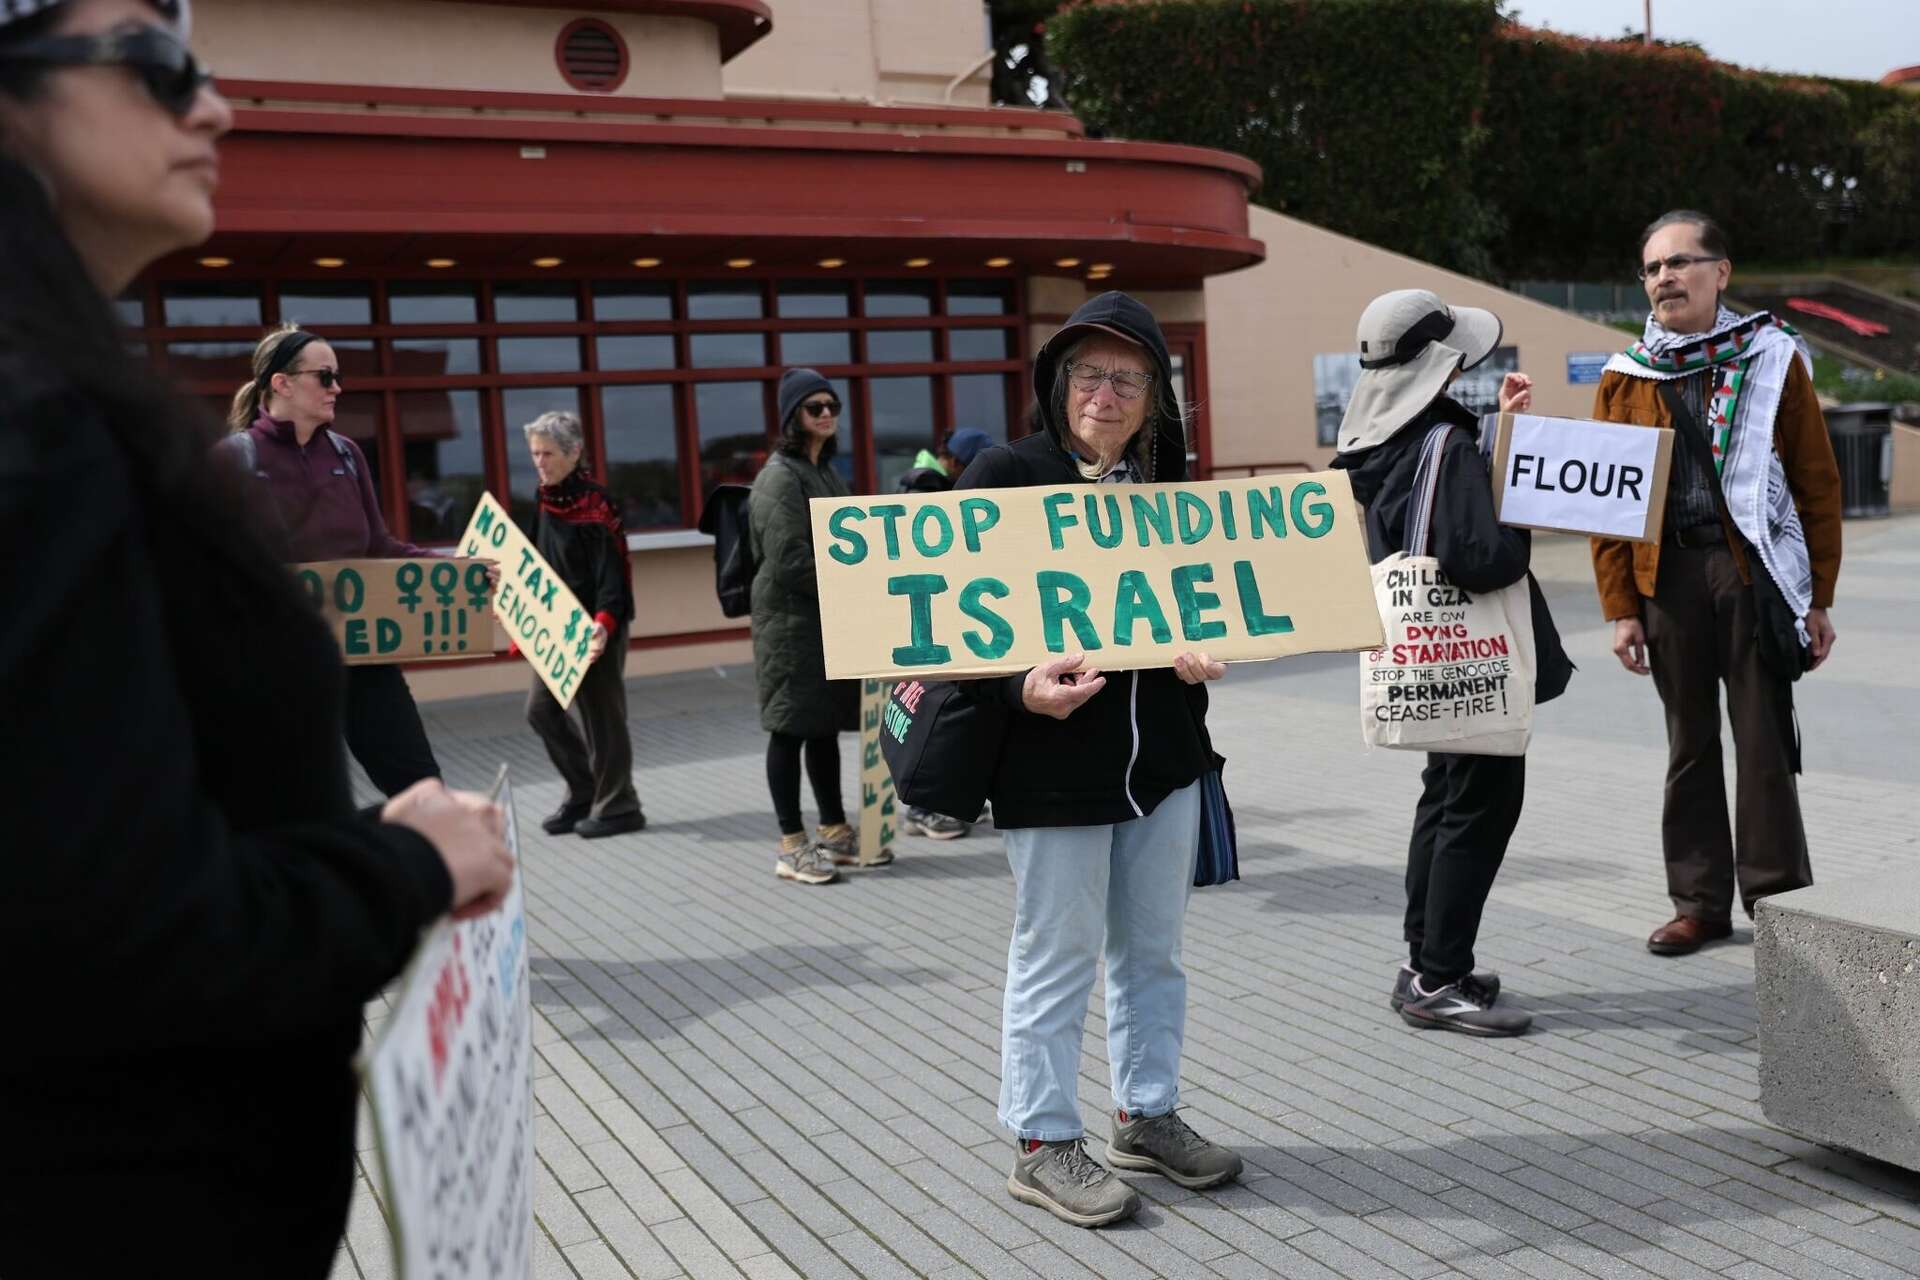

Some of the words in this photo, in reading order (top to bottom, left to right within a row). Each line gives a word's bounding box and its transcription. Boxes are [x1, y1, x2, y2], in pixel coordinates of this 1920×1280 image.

[1510, 453, 1644, 501] FLOUR
[828, 498, 1001, 565] STOP
[1043, 481, 1335, 552] FUNDING
[475, 504, 506, 548] NO
[516, 547, 560, 612] TAX
[1392, 590, 1413, 607] IN
[1427, 588, 1473, 608] GZA
[887, 560, 1295, 667] ISRAEL
[1400, 611, 1433, 623] ARE
[1441, 611, 1465, 624] OW
[498, 583, 579, 699] ENOCIDE
[1406, 623, 1468, 641] DYNG
[1369, 651, 1385, 662] OF
[1392, 635, 1509, 665] STARVATION
[1372, 670, 1405, 682] STOP
[1412, 669, 1434, 681] THE
[1441, 660, 1511, 681] GENOCIDE
[1388, 675, 1508, 702] PERMANENT
